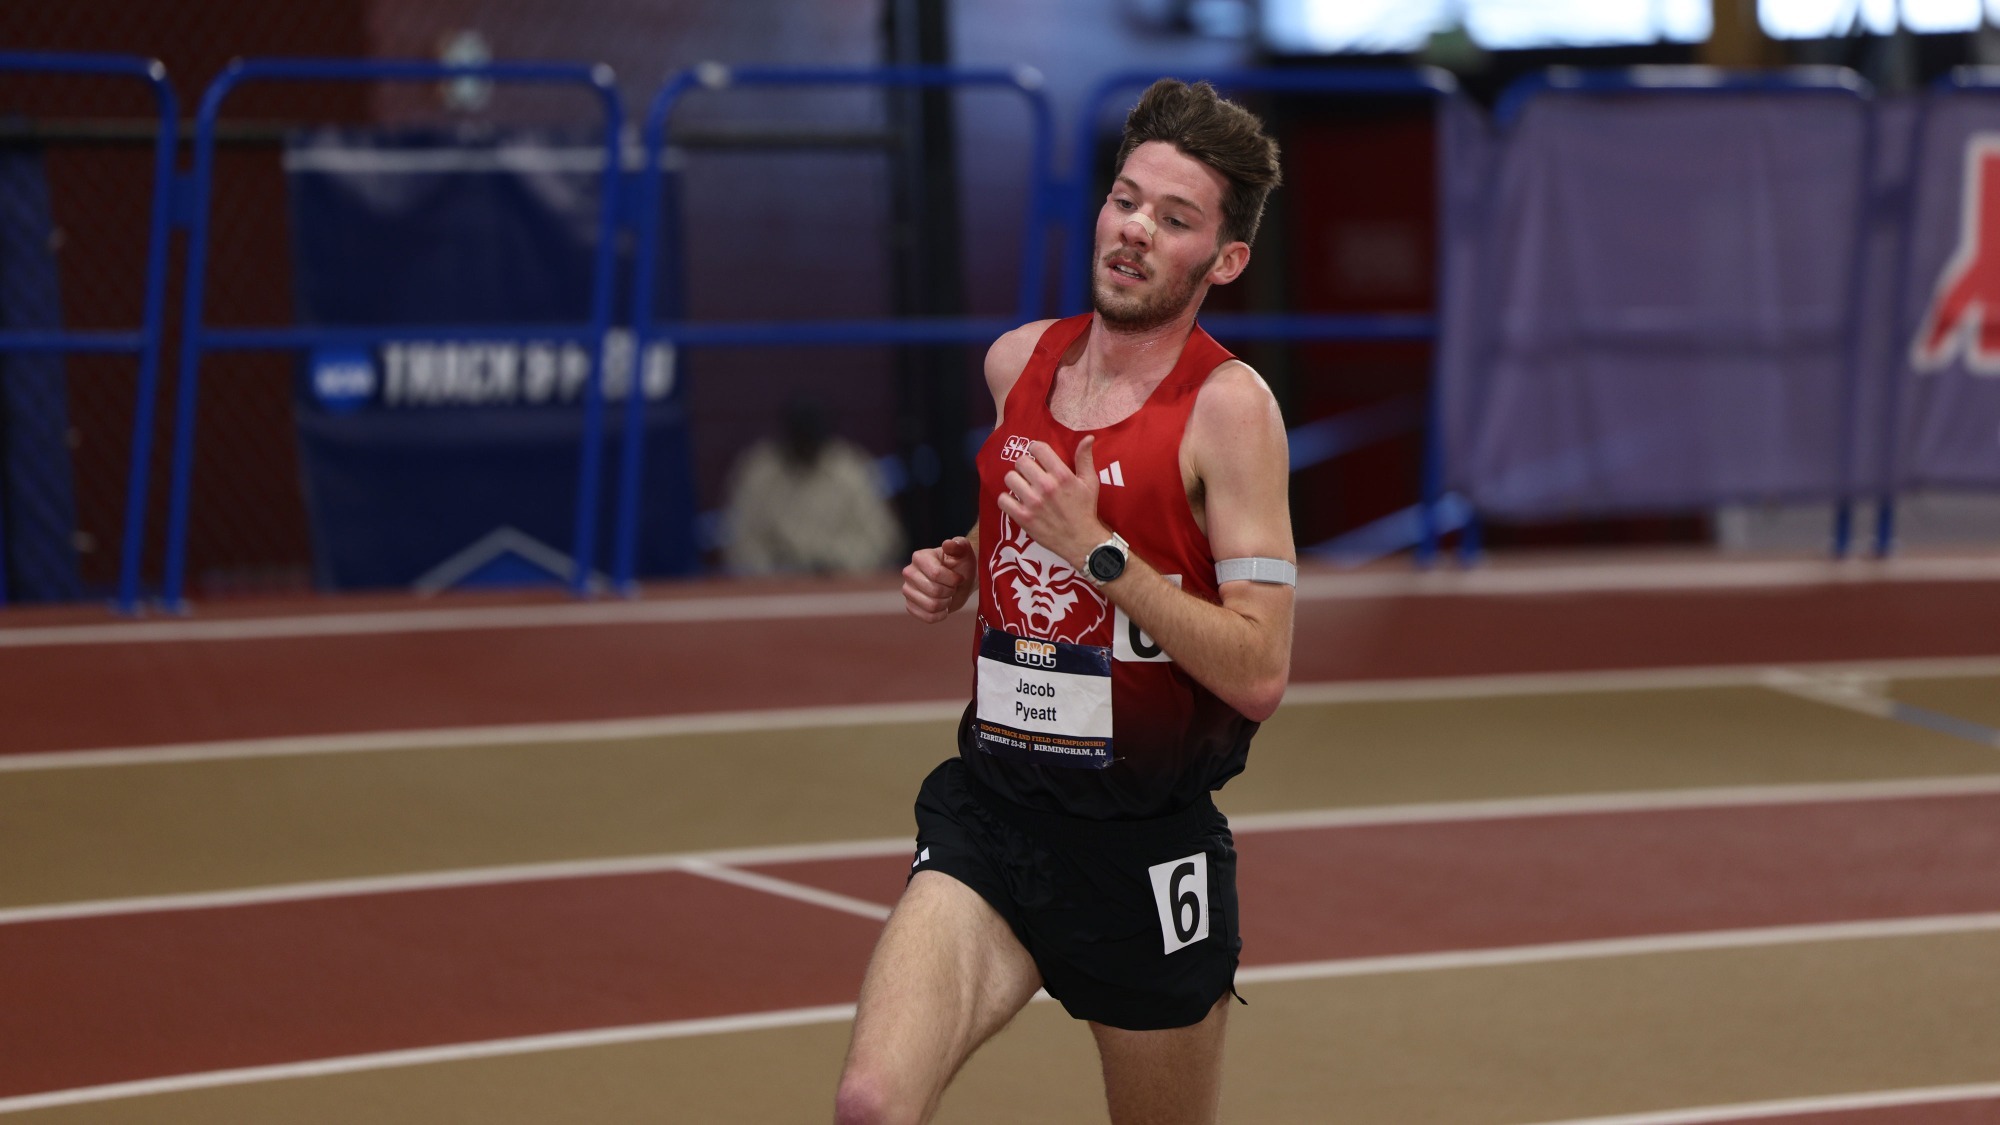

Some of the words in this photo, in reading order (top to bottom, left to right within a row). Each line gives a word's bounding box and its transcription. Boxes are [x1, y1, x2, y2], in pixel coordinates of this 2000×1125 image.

[1015, 638, 1056, 668] SBC
[1016, 678, 1055, 698] Jacob
[1015, 701, 1057, 722] Pyeatt
[980, 732, 1010, 745] FEBRUARY
[1010, 739, 1027, 750] 23-25
[1033, 743, 1093, 757] BIRMINGHAM,
[1094, 748, 1106, 756] AL
[1001, 729, 1018, 739] TRACK
[1032, 736, 1051, 744] FIELD
[1052, 738, 1106, 748] CHAMPIONSHIP
[1169, 861, 1200, 943] 6
